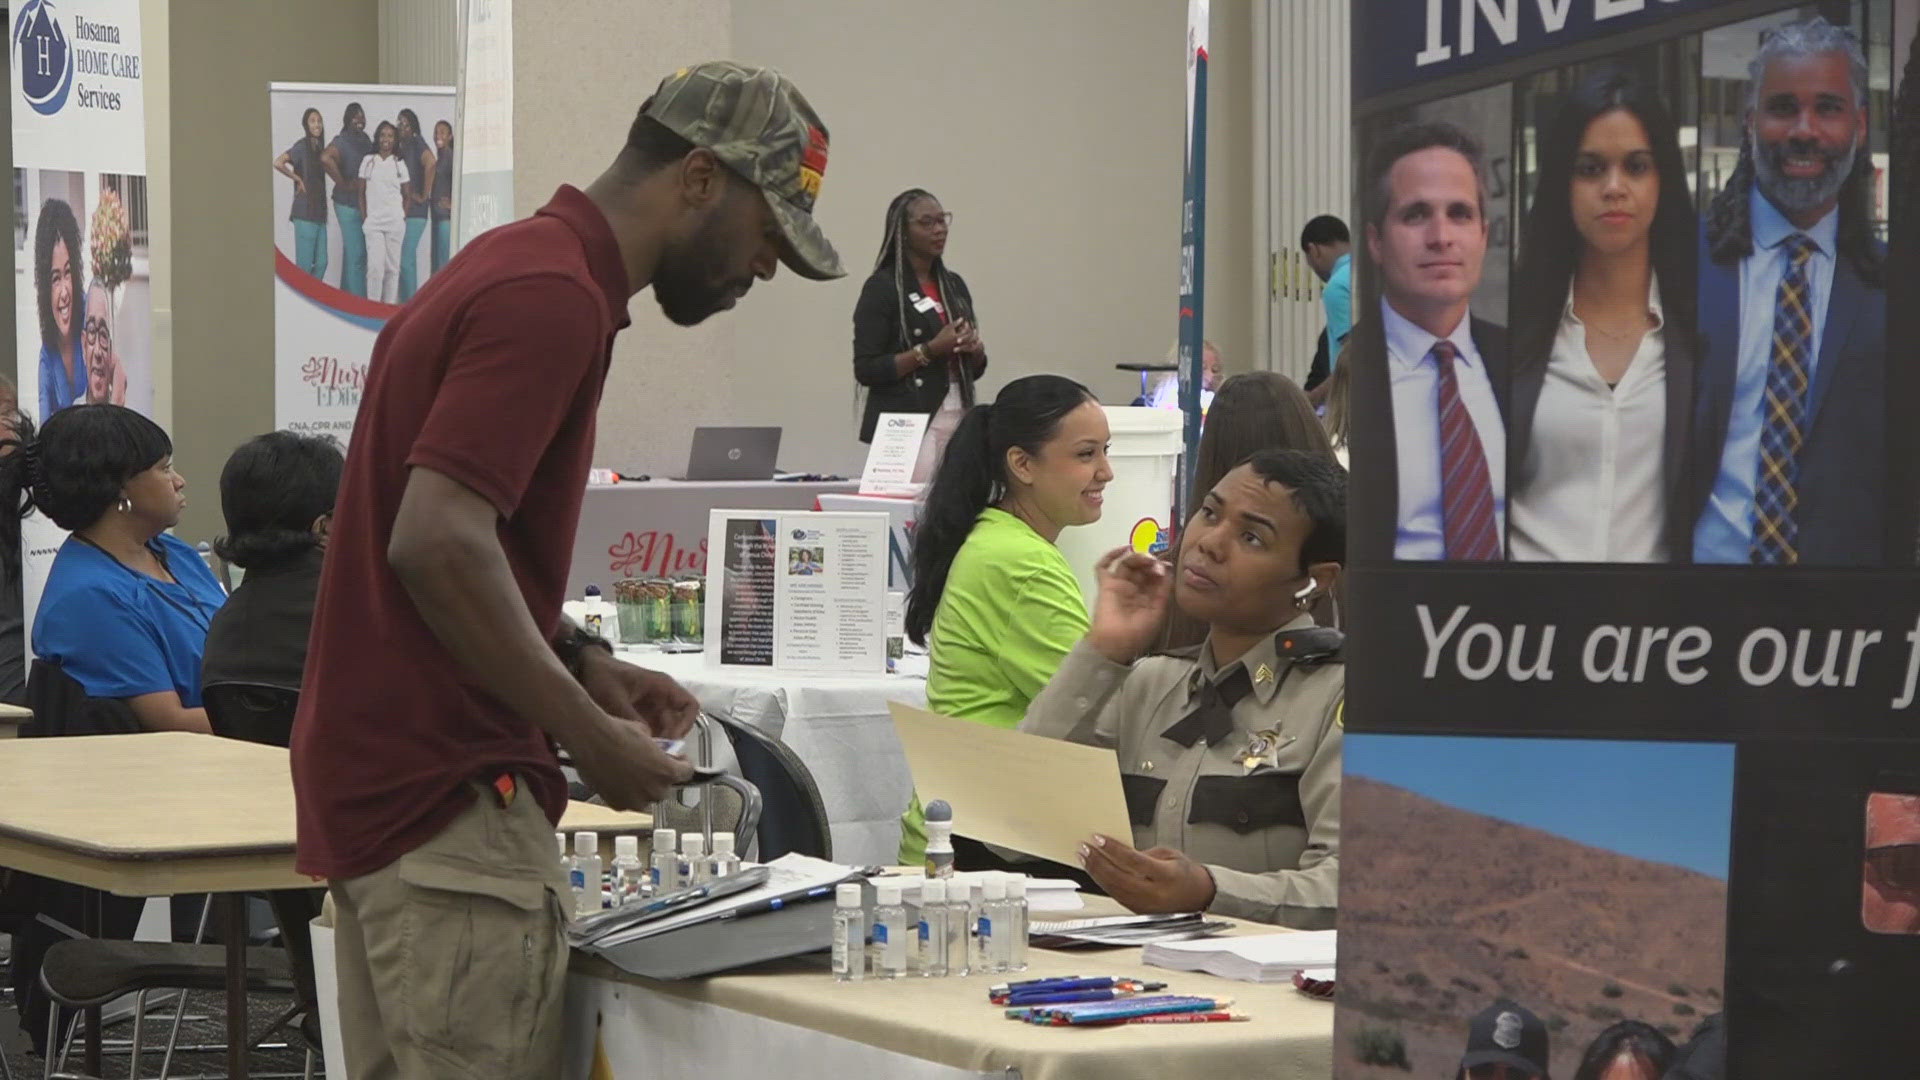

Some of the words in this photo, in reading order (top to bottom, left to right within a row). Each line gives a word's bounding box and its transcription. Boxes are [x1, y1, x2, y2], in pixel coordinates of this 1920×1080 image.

[75, 15, 121, 45] Hosanna
[37, 35, 51, 76] H
[76, 49, 109, 76] HOME
[110, 52, 140, 80] CARE
[77, 82, 121, 111] Services
[312, 421, 331, 430] CPR
[332, 420, 352, 430] AND
[1415, 605, 1556, 681] You
[1581, 624, 1713, 685] are
[1737, 626, 1882, 687] our
